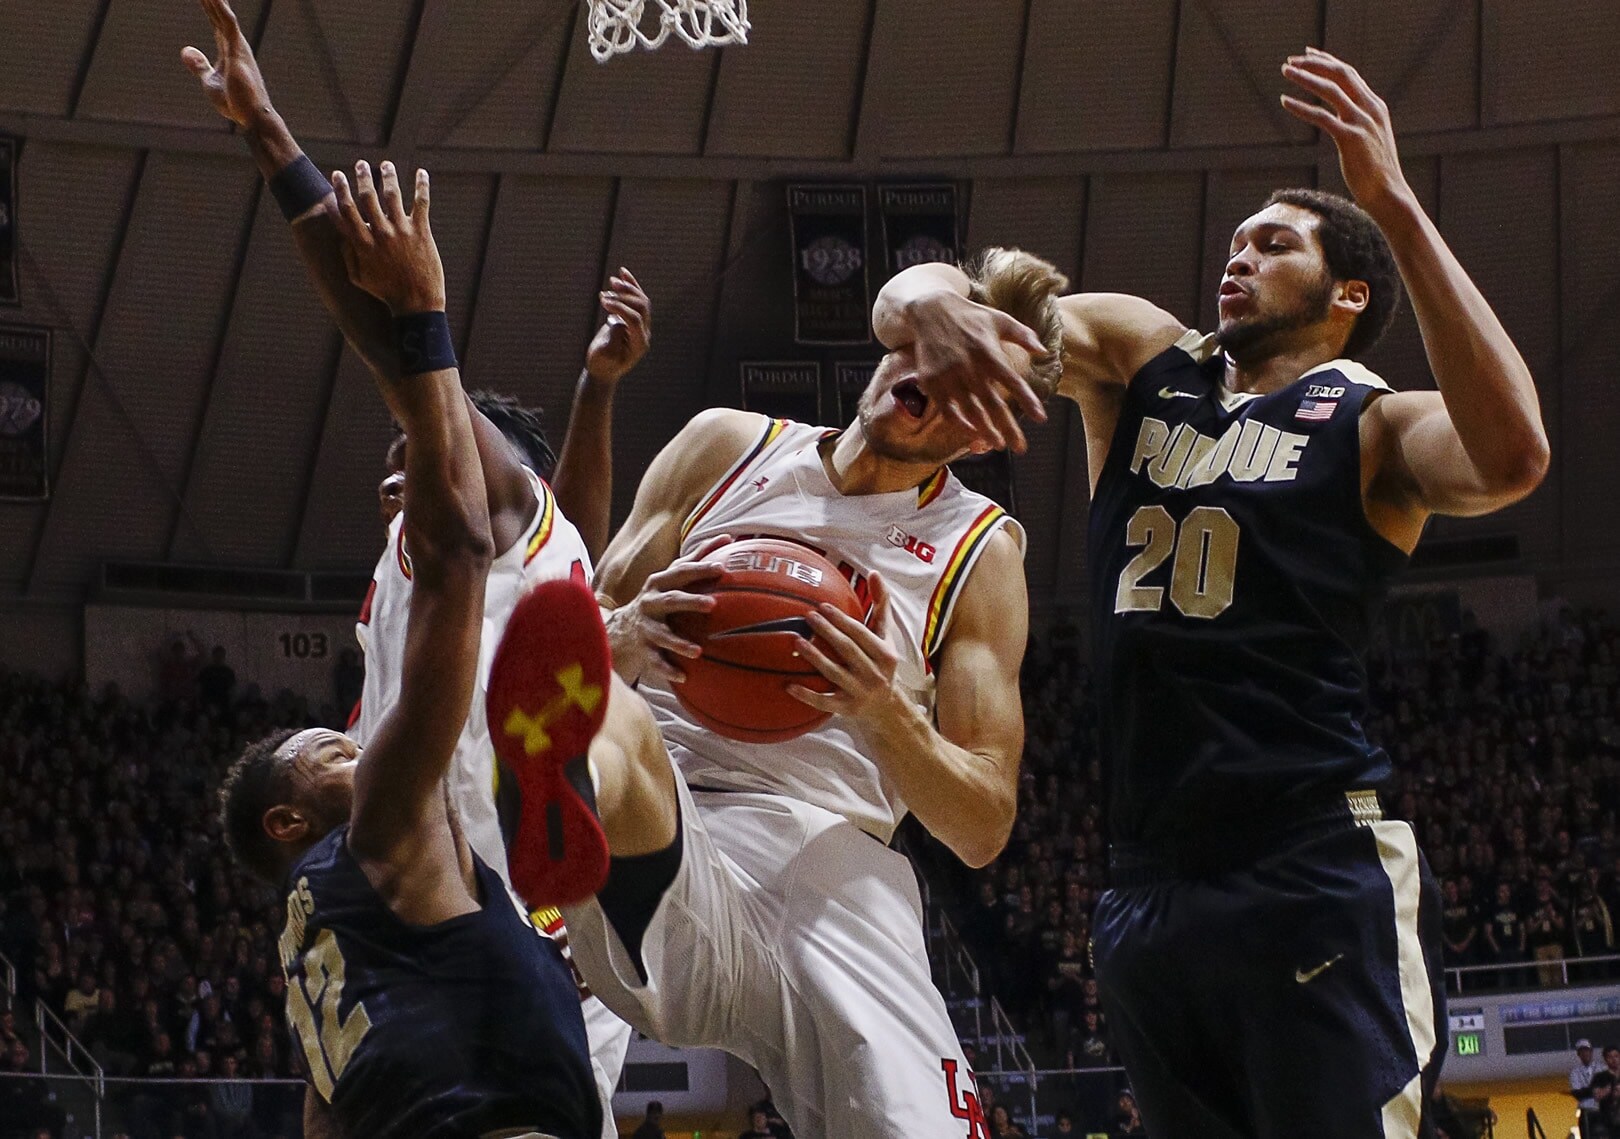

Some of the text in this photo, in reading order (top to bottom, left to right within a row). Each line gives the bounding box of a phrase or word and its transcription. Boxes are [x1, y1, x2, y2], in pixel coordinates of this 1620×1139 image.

[793, 191, 860, 206] PURDUE
[885, 191, 952, 206] PURDUE
[801, 248, 862, 271] 1928
[748, 367, 816, 383] PURDUE
[1129, 416, 1310, 490] PURDUE
[1114, 504, 1240, 619] 20
[279, 633, 328, 659] 103
[285, 927, 373, 1104] 12
[1457, 1035, 1480, 1055] EXIT
